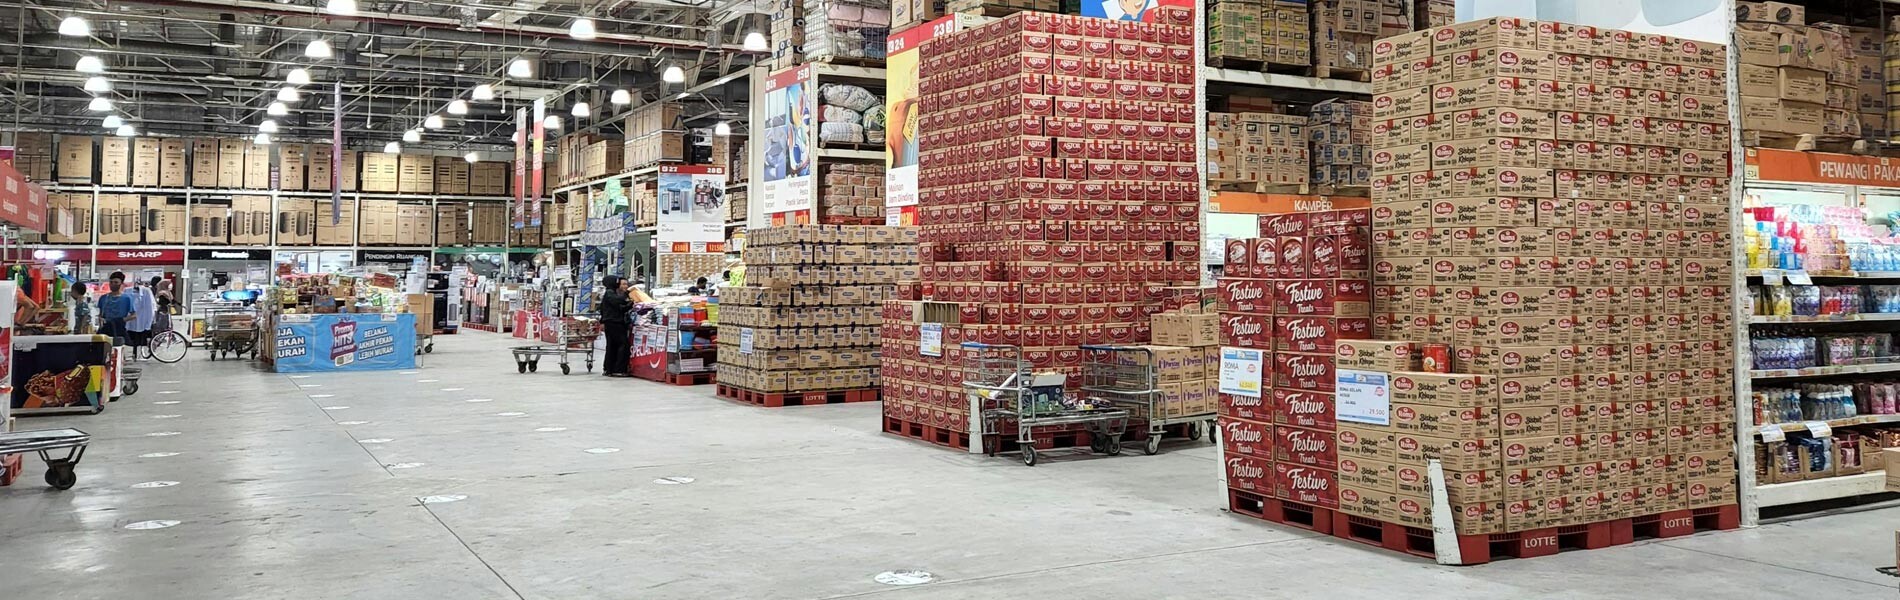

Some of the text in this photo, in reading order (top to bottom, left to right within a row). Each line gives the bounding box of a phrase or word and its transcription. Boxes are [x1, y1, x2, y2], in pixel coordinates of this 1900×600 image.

[934, 24, 945, 36] 23
[895, 38, 904, 50] 24
[1060, 39, 1078, 47] ASTOR
[1820, 161, 1870, 179] PEWANGI
[1294, 200, 1333, 210] KAMPER
[1268, 216, 1303, 235] Festive
[1226, 281, 1263, 301] Festive
[1285, 282, 1323, 304] Festive
[1237, 302, 1253, 311] Treats
[1296, 304, 1313, 313] Treats
[364, 326, 388, 338] BELANJA
[1228, 316, 1262, 336] Festive
[1287, 319, 1325, 341] Festive
[360, 338, 376, 349] AKHIR
[376, 336, 394, 346] PEKAN
[1237, 337, 1252, 346] Treats
[1298, 341, 1315, 350] Treats
[358, 349, 374, 360] LEBIH
[1287, 356, 1326, 378] Festive
[1299, 379, 1316, 388] Treats
[1285, 393, 1325, 414] Festive
[1237, 408, 1253, 417] Treats
[1297, 416, 1314, 425] Treats
[1227, 422, 1262, 442] Festive
[1287, 430, 1326, 452] Festive
[1236, 443, 1252, 453] Treats
[1299, 453, 1316, 464] Treats
[1228, 458, 1264, 479] Festive
[1239, 479, 1254, 489] Treats
[1287, 468, 1328, 490] Festive
[1299, 491, 1317, 502] Treats
[1664, 518, 1692, 529] LOTTE
[1524, 536, 1556, 548] LOTTE
